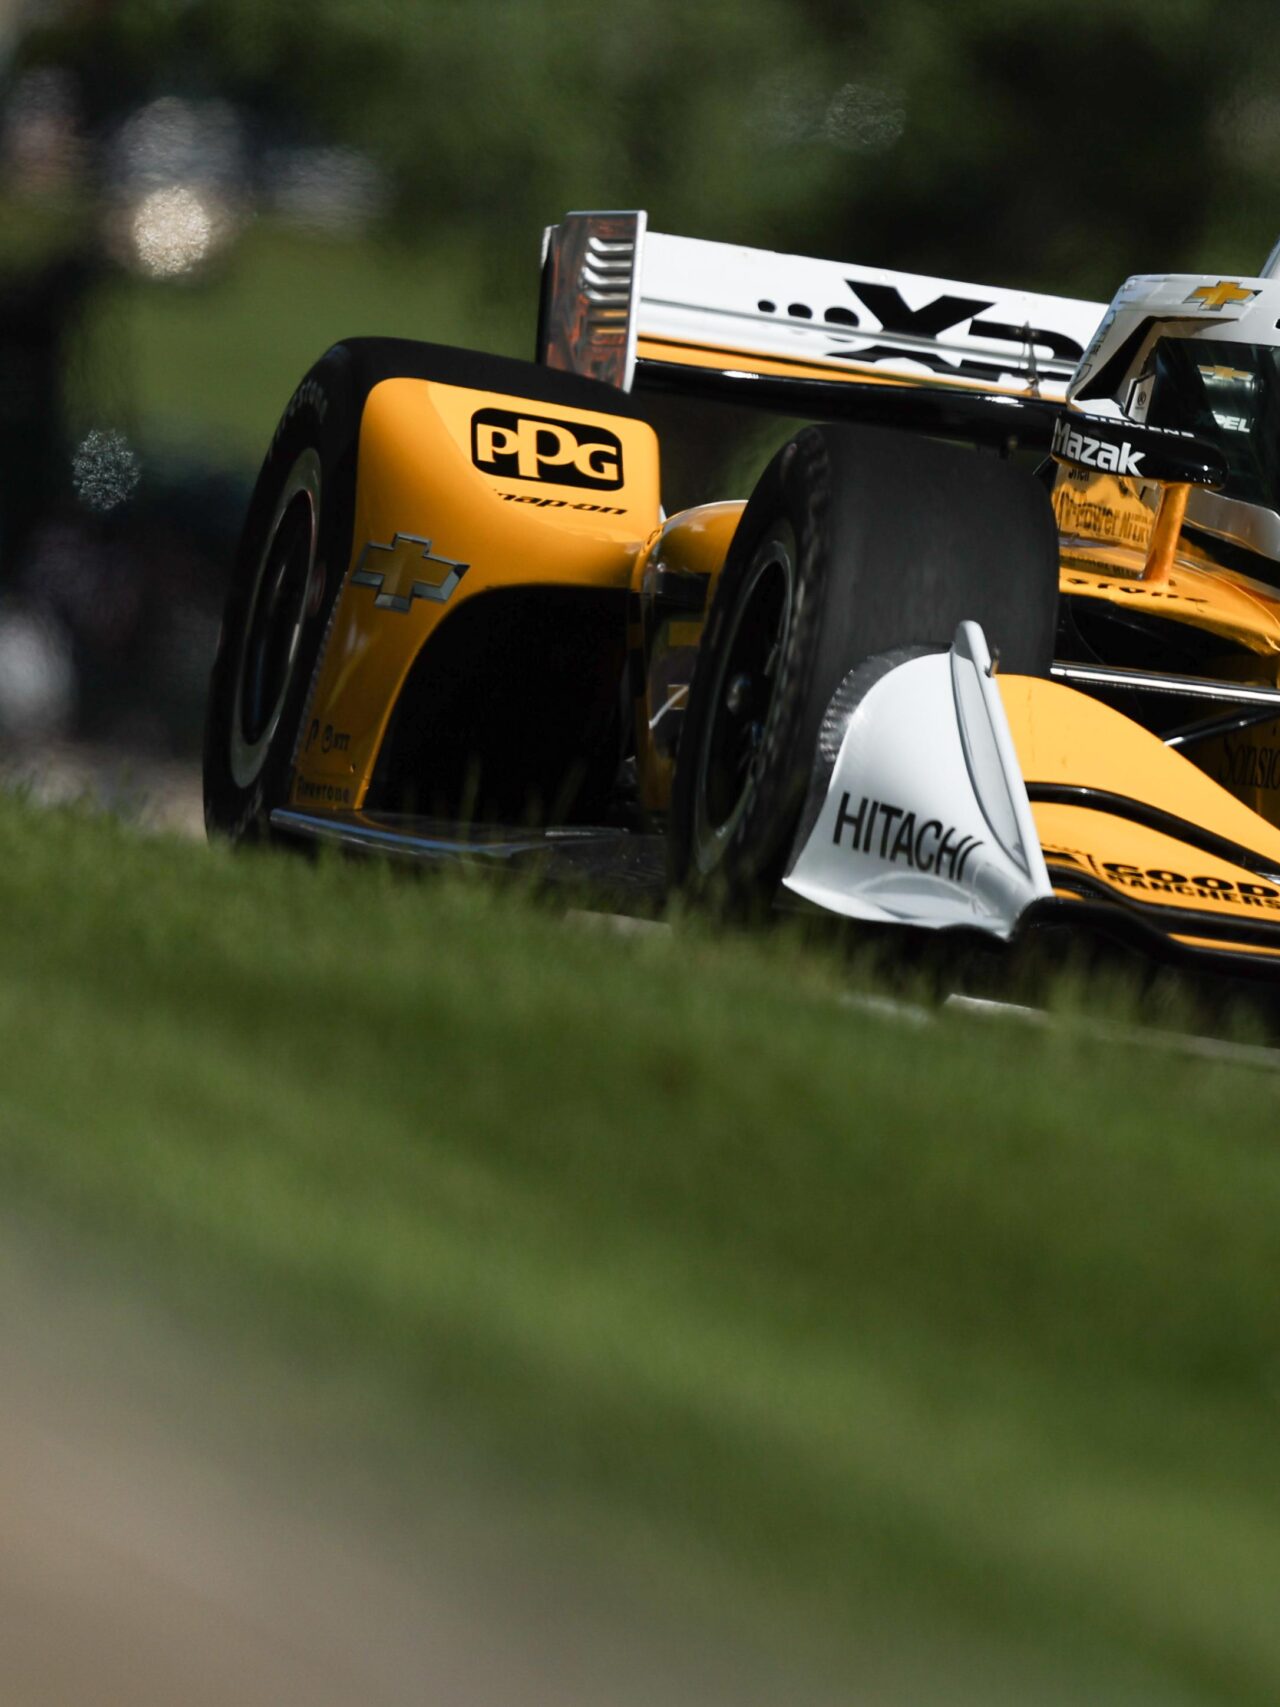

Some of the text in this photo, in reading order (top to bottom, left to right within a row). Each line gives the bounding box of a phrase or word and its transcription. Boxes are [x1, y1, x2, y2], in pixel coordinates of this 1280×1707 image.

[477, 419, 618, 480] PPG
[1051, 418, 1145, 477] Mazak
[494, 489, 627, 515] nap-on
[833, 793, 983, 882] HITACHI
[1102, 862, 1280, 898] GOOD
